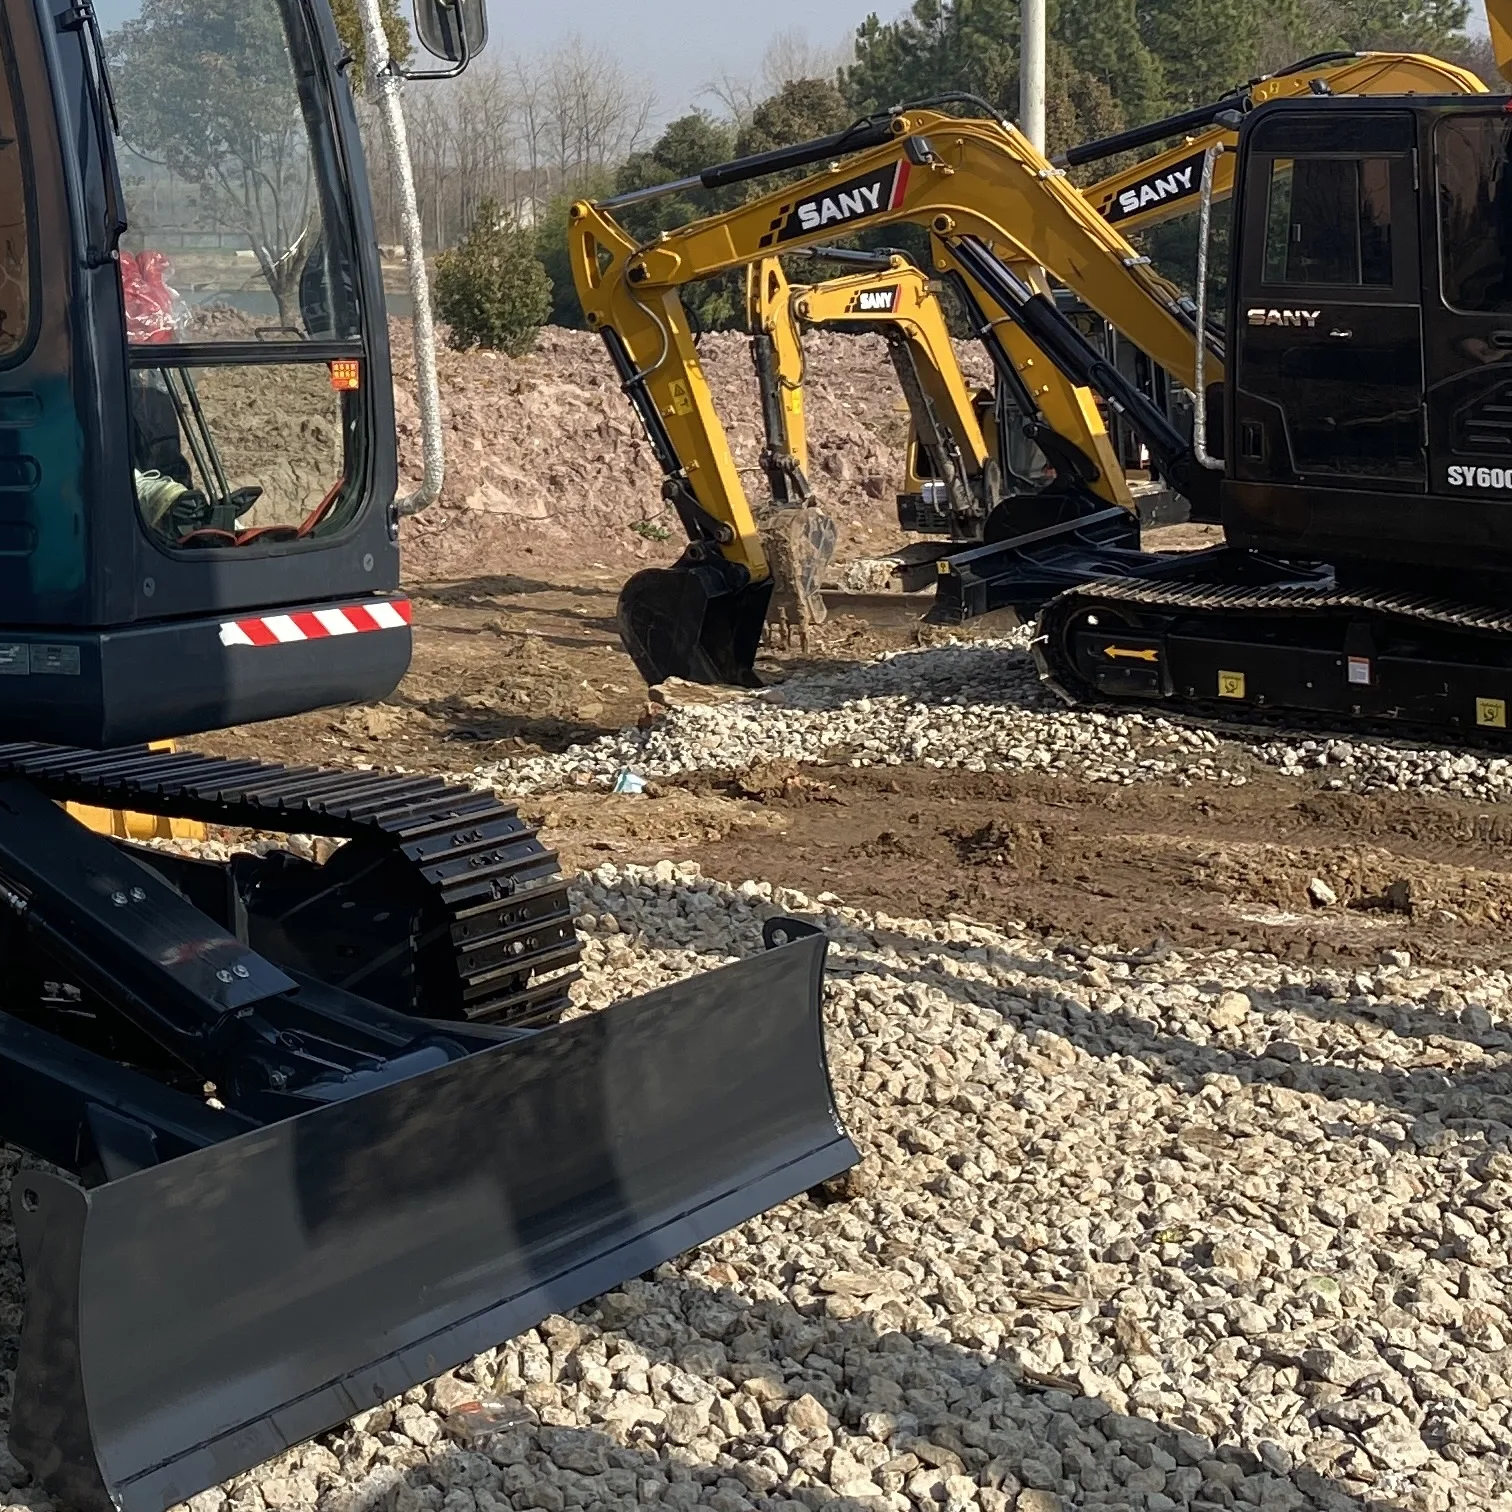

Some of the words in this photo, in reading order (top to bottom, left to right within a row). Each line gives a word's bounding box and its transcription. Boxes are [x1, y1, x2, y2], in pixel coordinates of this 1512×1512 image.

[1119, 167, 1193, 213] SANY
[797, 182, 881, 231] SANY
[859, 292, 893, 310] SANY
[1247, 309, 1321, 327] SANY
